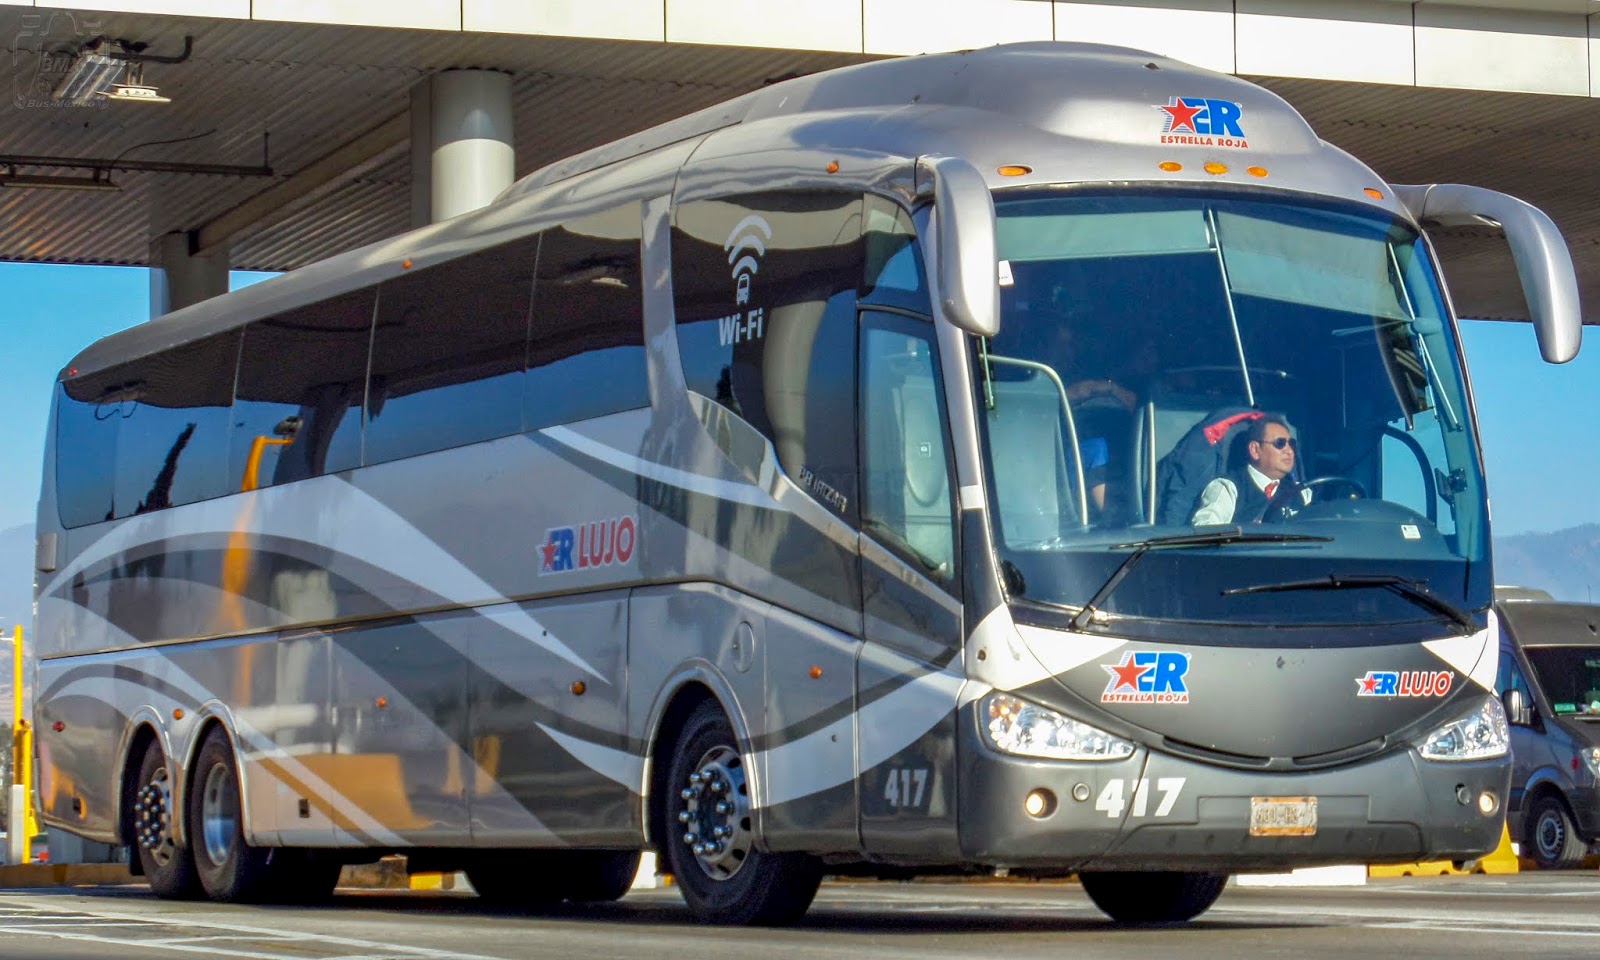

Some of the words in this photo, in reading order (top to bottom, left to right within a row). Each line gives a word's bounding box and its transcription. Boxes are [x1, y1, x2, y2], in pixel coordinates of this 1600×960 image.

[1160, 135, 1213, 146] ESTRELLA
[1217, 138, 1248, 148] ROJA
[718, 307, 763, 347] Wi-Fi
[578, 516, 636, 569] LUJO
[1102, 693, 1154, 702] ESTRELLA
[1157, 693, 1188, 702] ROJA
[1399, 672, 1452, 696] LUJO
[884, 768, 928, 807] 417
[1095, 777, 1187, 818] 417
